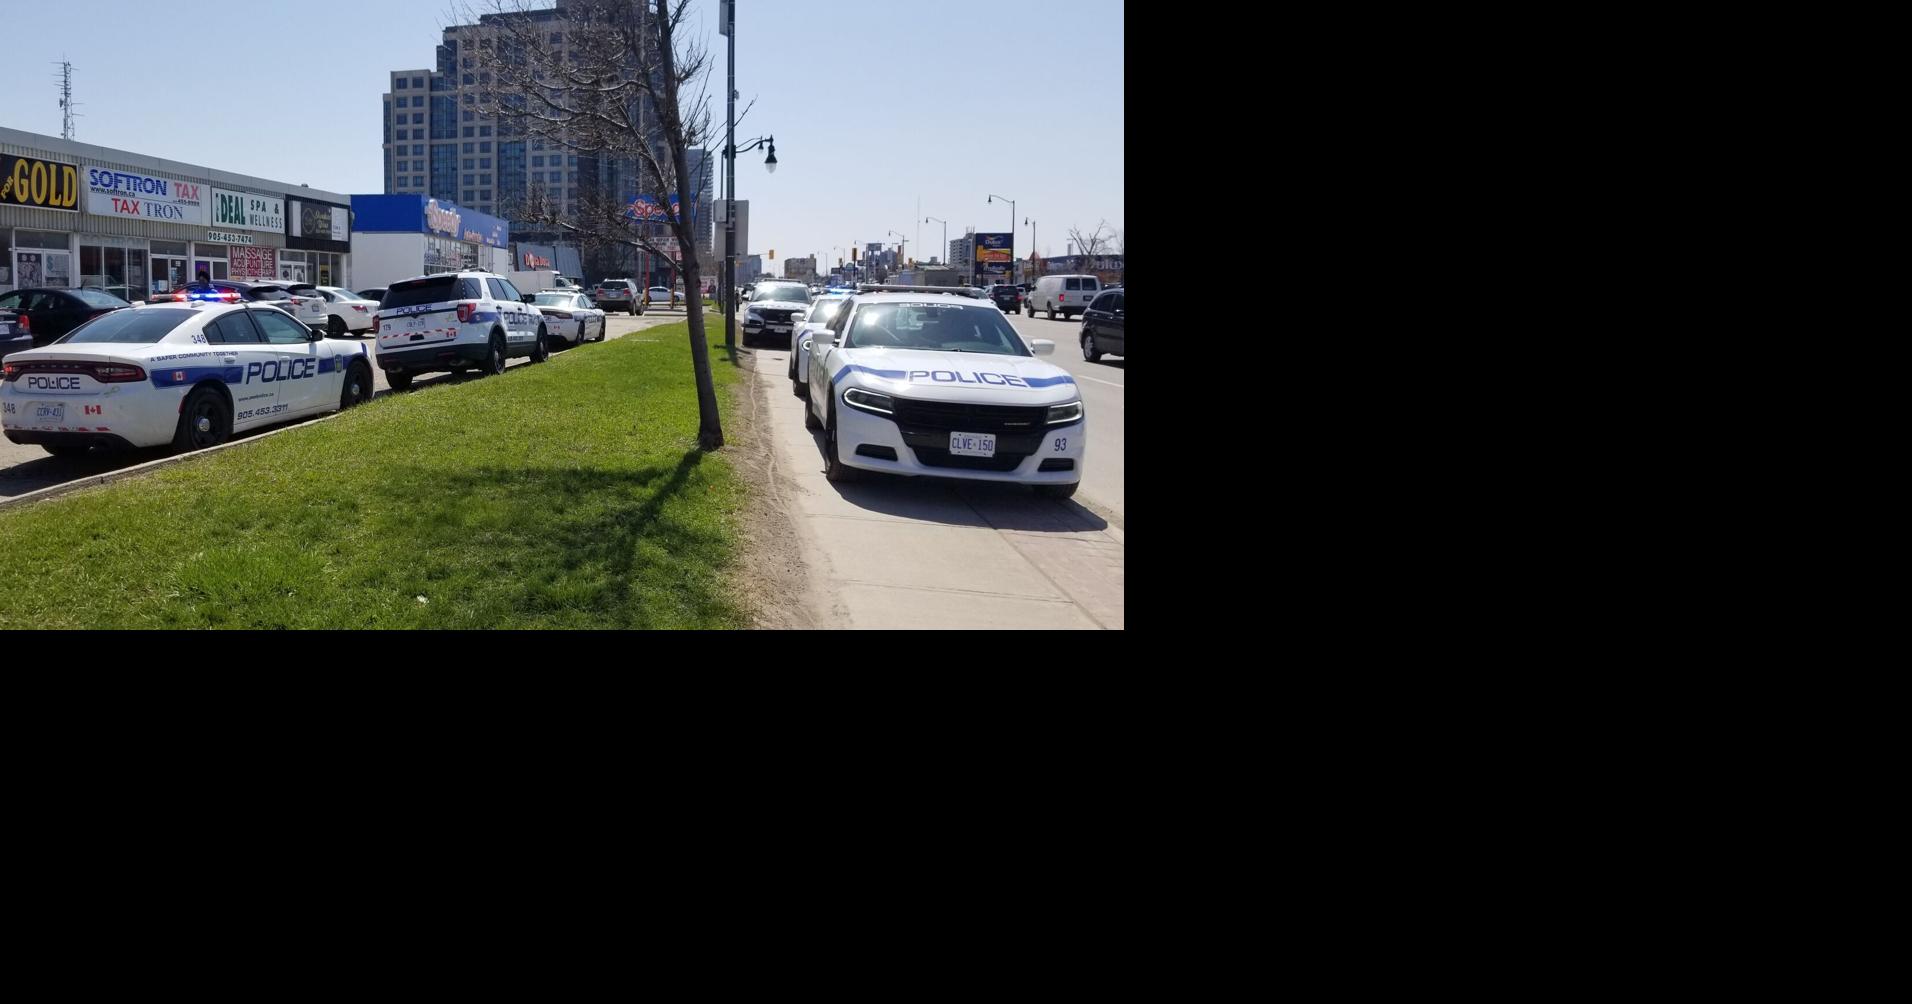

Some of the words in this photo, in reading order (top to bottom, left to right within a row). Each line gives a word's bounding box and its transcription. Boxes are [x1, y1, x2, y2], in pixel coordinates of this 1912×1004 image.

[1, 175, 14, 199] FOR
[14, 158, 77, 207] GOLD
[90, 168, 167, 196] SOFTRON
[174, 182, 200, 200] TAX
[112, 197, 140, 215] TAX
[144, 201, 183, 219] TRON
[250, 199, 266, 212] SPA
[274, 203, 280, 214] &
[250, 213, 283, 229] WELLNESS
[232, 246, 273, 260] MASSAGE
[397, 304, 433, 315] POLICE
[191, 334, 207, 344] 348
[178, 351, 212, 359] COMMUNITY
[246, 357, 317, 385] POLICE
[28, 376, 81, 390] POLICE
[909, 370, 1028, 388] POLICE
[1054, 437, 1067, 451] 93
